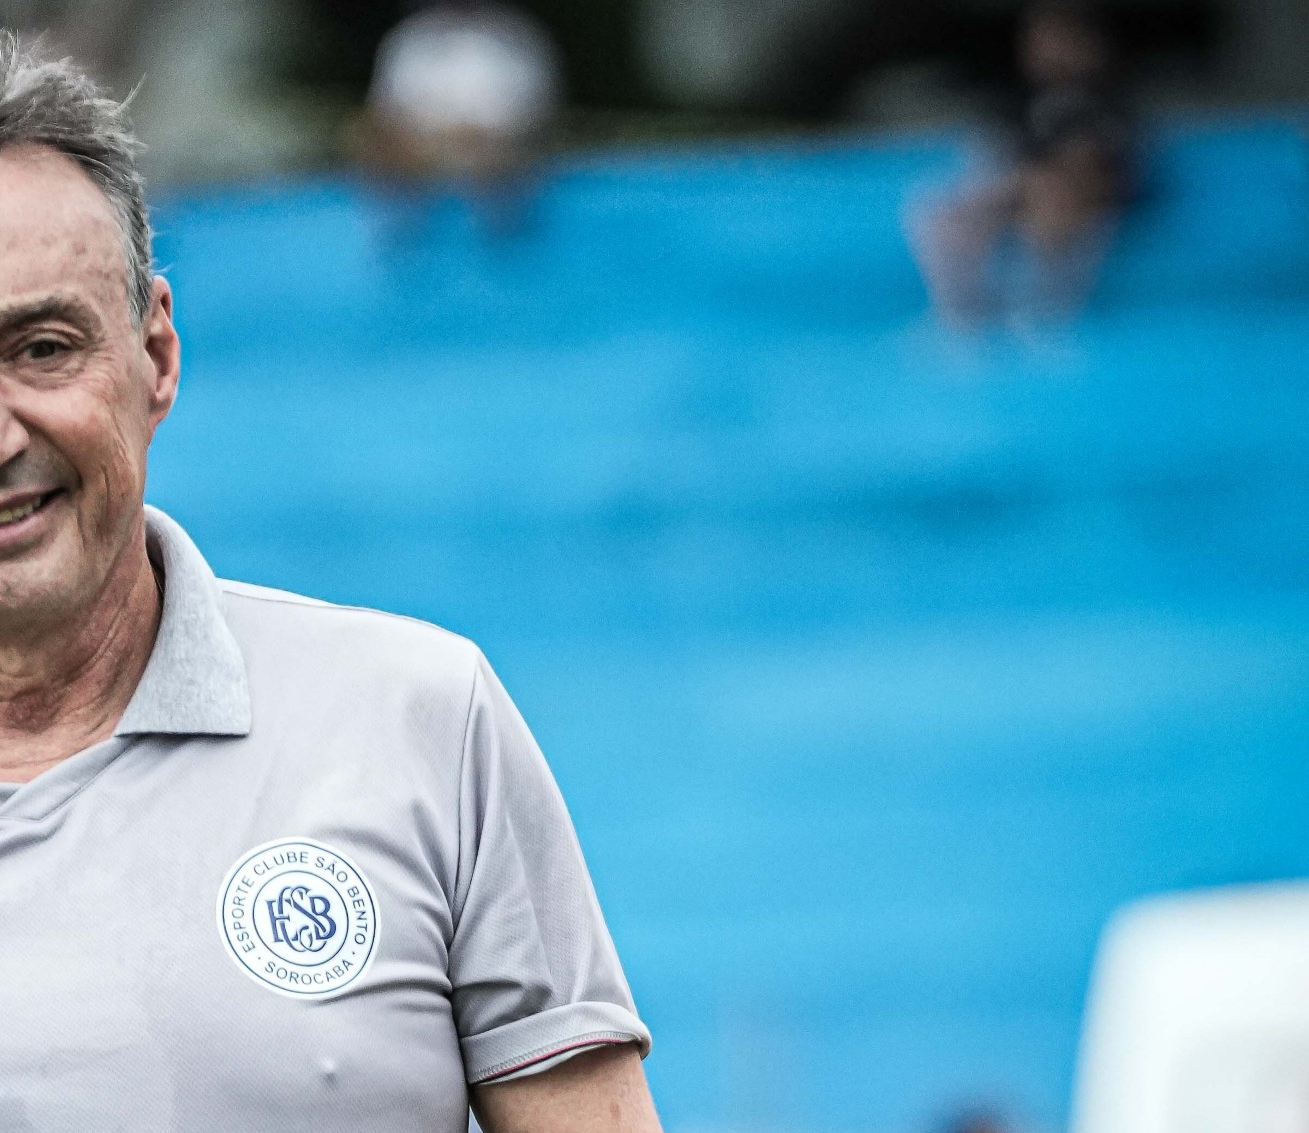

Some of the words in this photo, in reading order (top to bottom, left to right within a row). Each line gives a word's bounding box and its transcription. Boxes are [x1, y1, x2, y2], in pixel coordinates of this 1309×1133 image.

[231, 875, 255, 953] ESPORTE
[253, 851, 309, 876] CLUBE
[315, 856, 348, 883] SÃO
[347, 886, 368, 945] BENTO
[264, 958, 353, 985] SOROCABA
